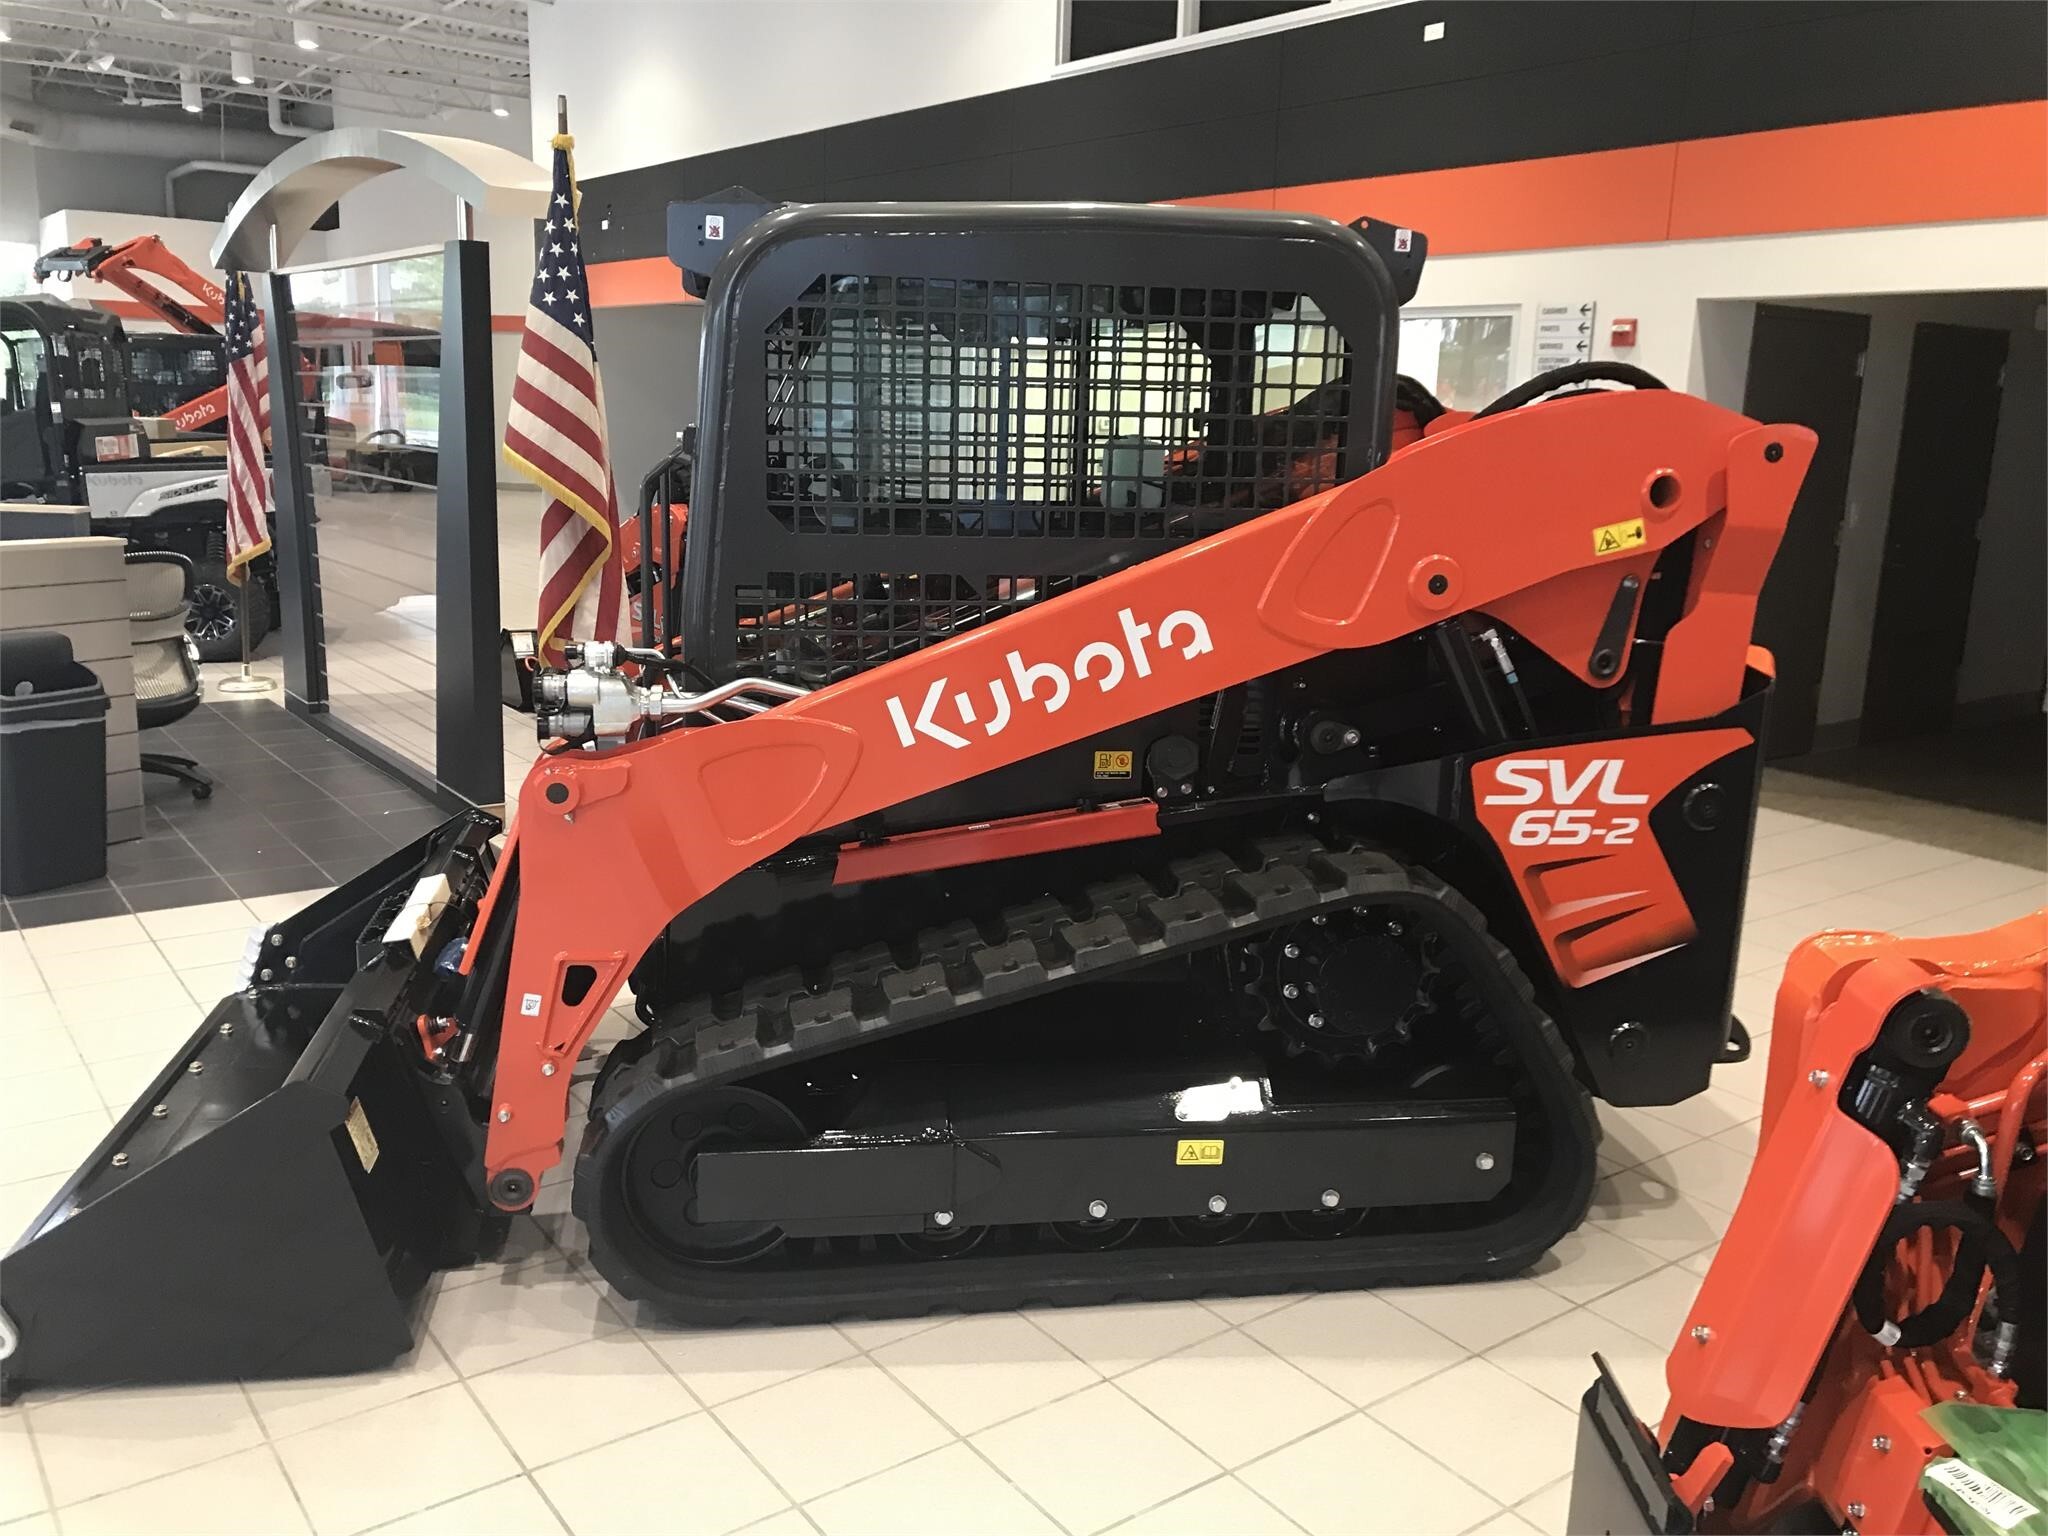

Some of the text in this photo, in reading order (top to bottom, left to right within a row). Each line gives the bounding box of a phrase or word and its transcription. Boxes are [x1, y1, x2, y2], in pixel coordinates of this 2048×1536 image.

[202, 282, 225, 305] Kub
[175, 403, 216, 431] ubota
[886, 607, 1214, 749] Kubota
[1484, 759, 1649, 805] SVL
[1509, 809, 1640, 846] 65-2
